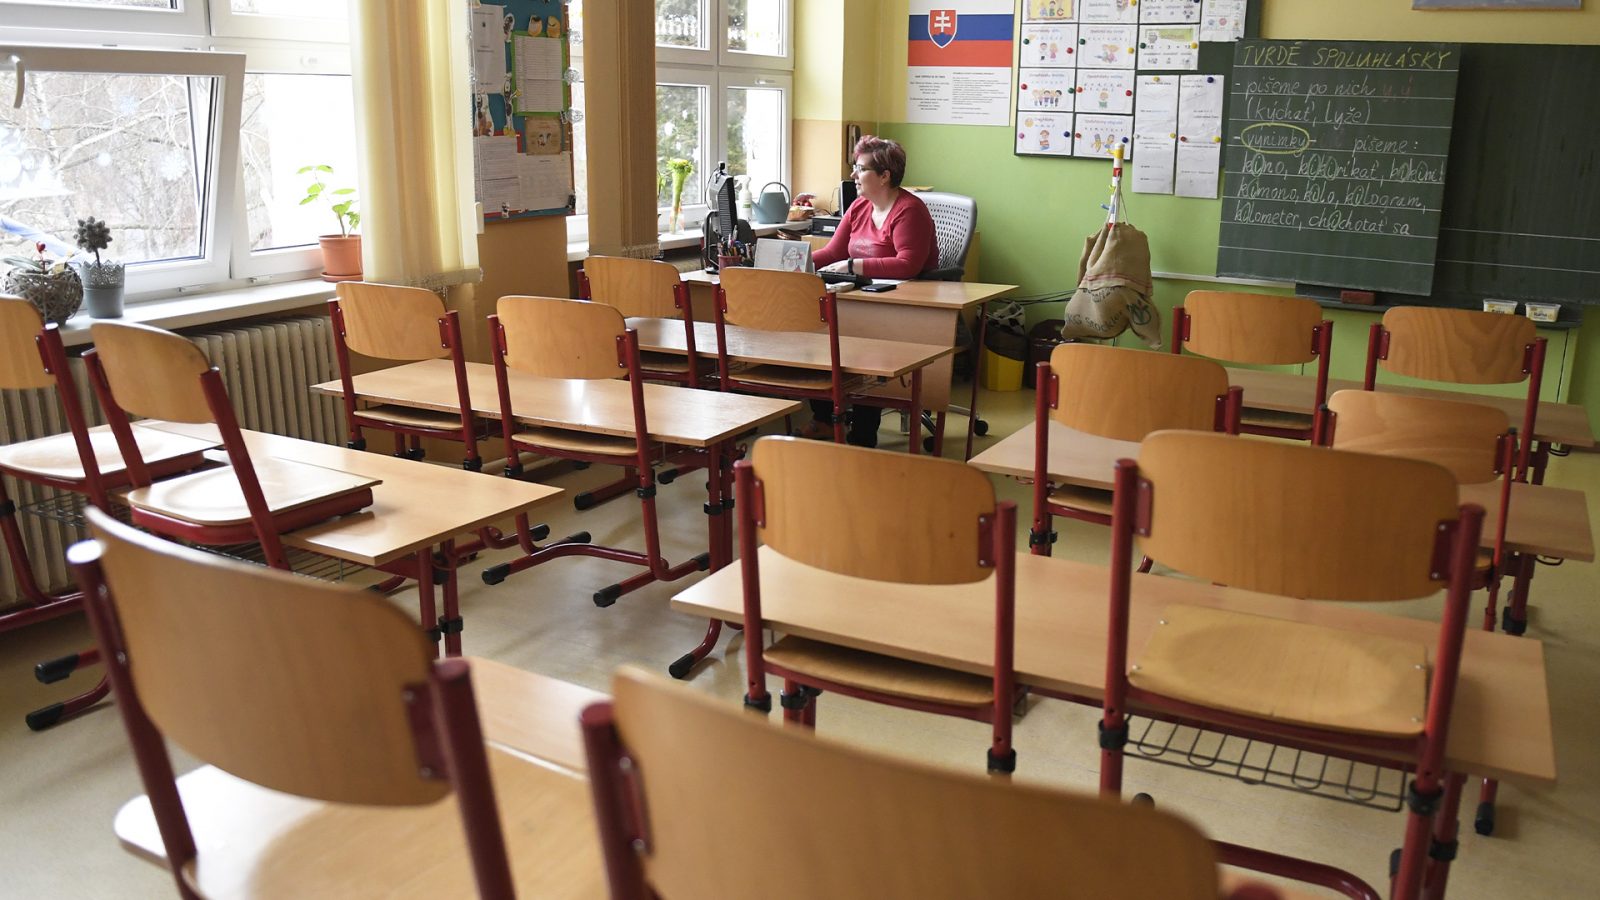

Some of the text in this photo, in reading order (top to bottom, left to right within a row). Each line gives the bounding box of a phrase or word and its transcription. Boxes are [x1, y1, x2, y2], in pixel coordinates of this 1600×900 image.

[1243, 42, 1451, 70] TVRDÉ SPOLUHLÁSKY
[1305, 83, 1328, 103] po
[1335, 75, 1376, 96] nich
[1393, 222, 1411, 236] sa
